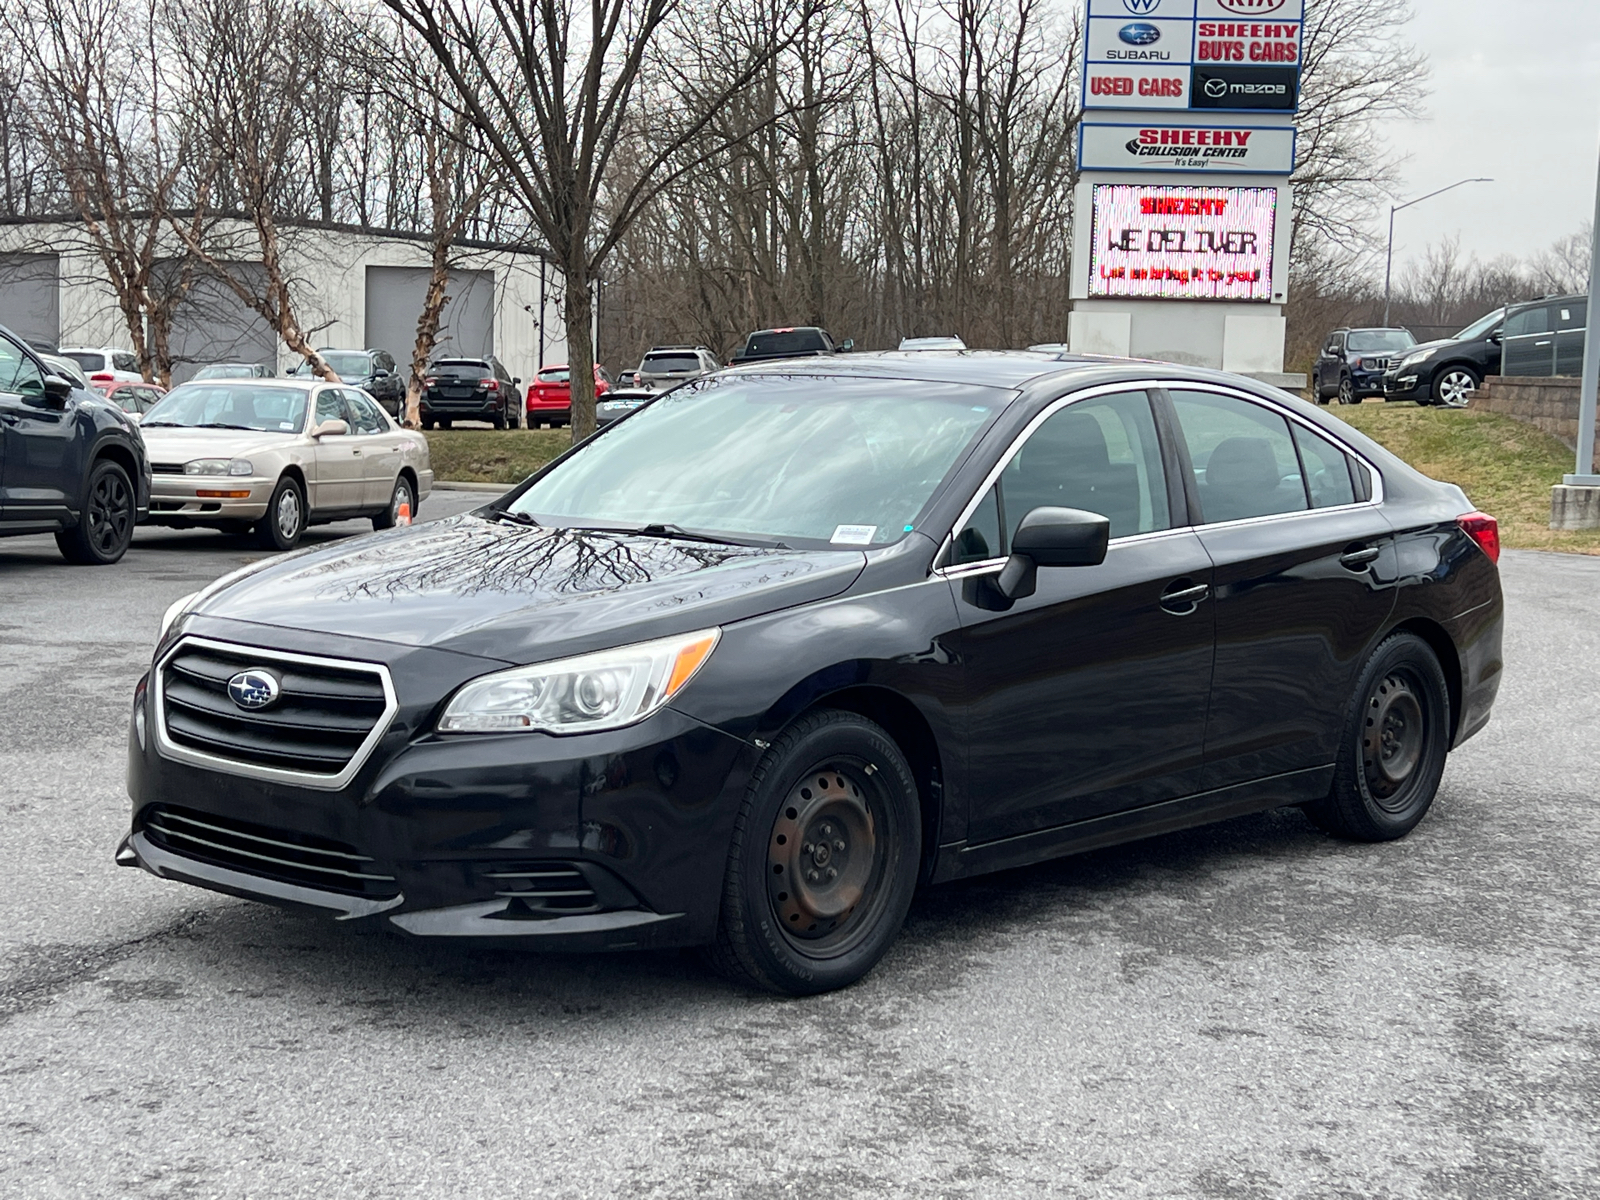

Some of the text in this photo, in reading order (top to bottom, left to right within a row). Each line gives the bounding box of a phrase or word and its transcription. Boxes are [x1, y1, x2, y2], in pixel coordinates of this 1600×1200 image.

[1199, 23, 1299, 38] SHEEHY
[1106, 50, 1170, 60] SUBARU
[1198, 41, 1298, 62] BUYS CARS
[1090, 77, 1183, 97] USED CARS
[1138, 129, 1252, 146] SHEEHY
[1139, 146, 1248, 158] COLLISION CENTER
[1187, 158, 1209, 168] Easy!
